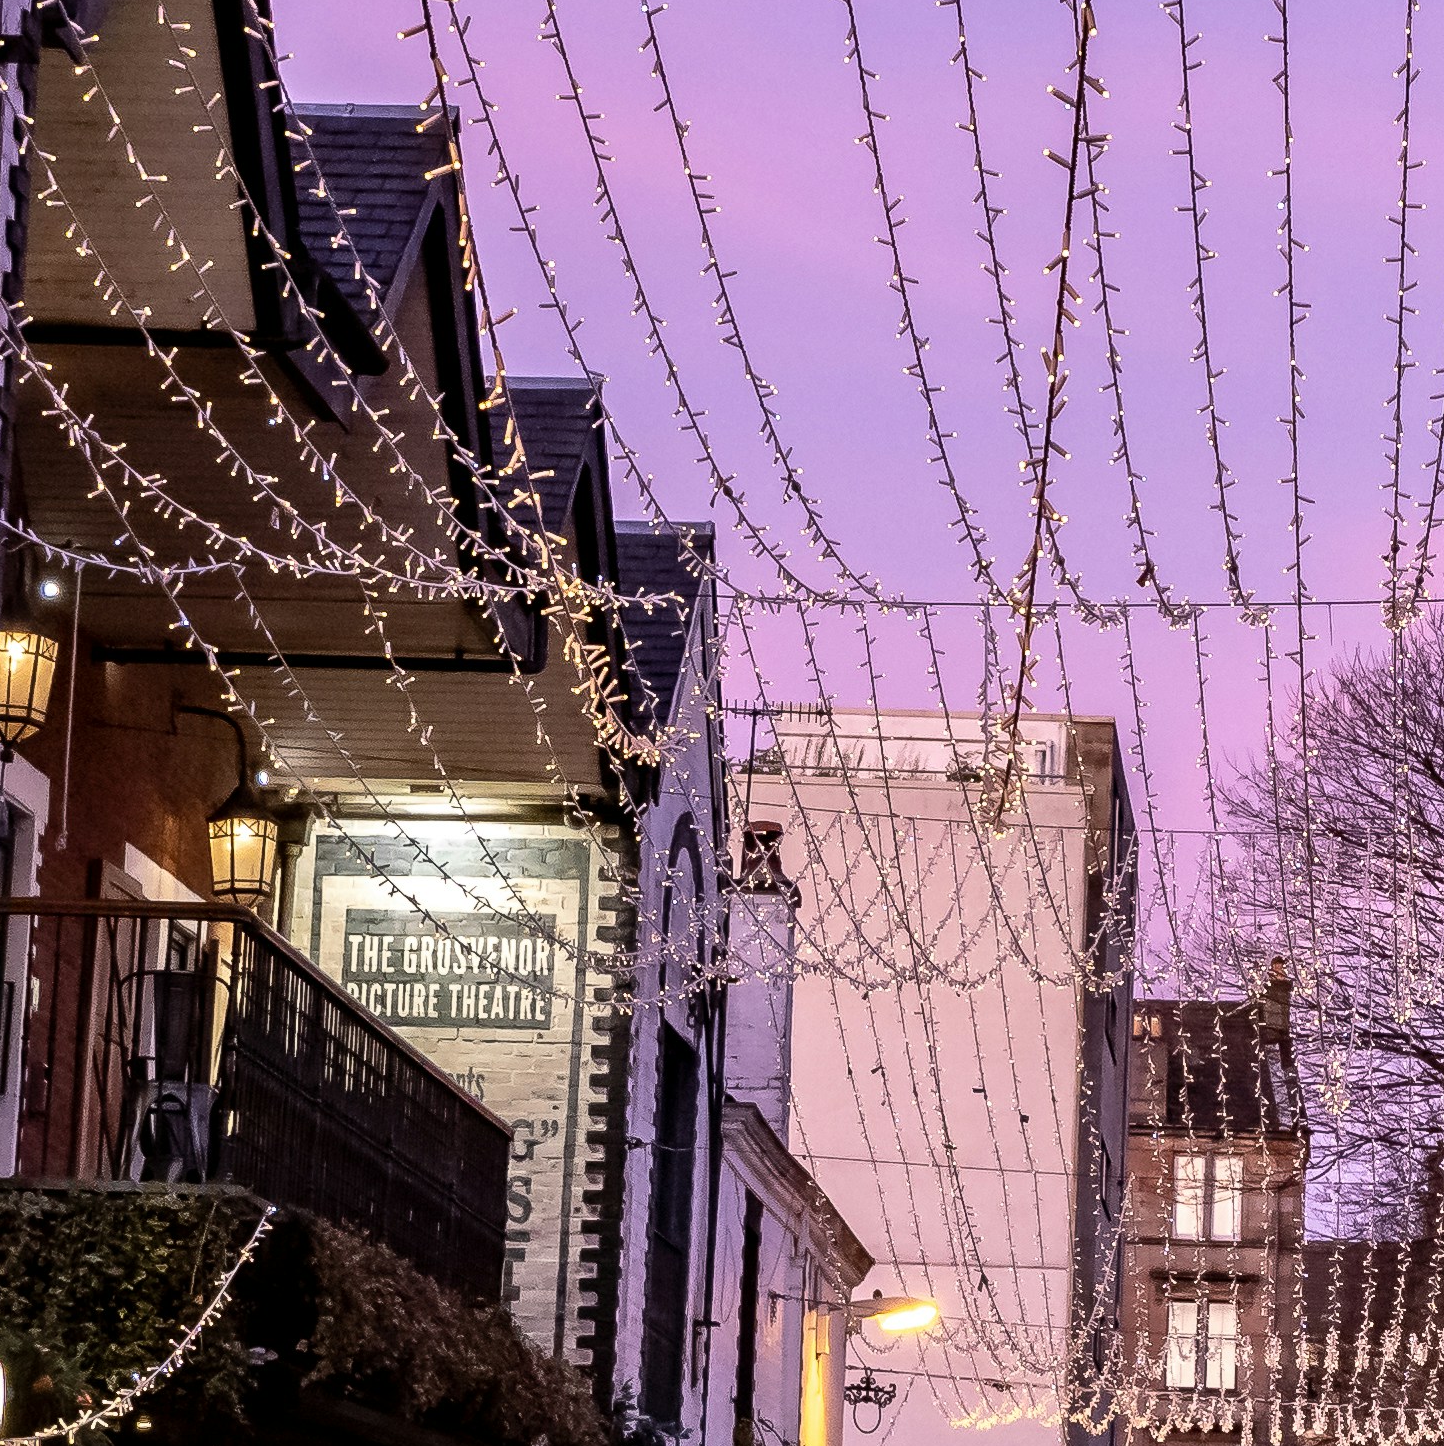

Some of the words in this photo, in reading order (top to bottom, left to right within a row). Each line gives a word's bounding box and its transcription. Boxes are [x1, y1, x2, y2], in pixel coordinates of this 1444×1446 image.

[349, 934, 394, 974] THE
[404, 934, 551, 977] GROSVENOR
[449, 984, 546, 1022] THEATRE
